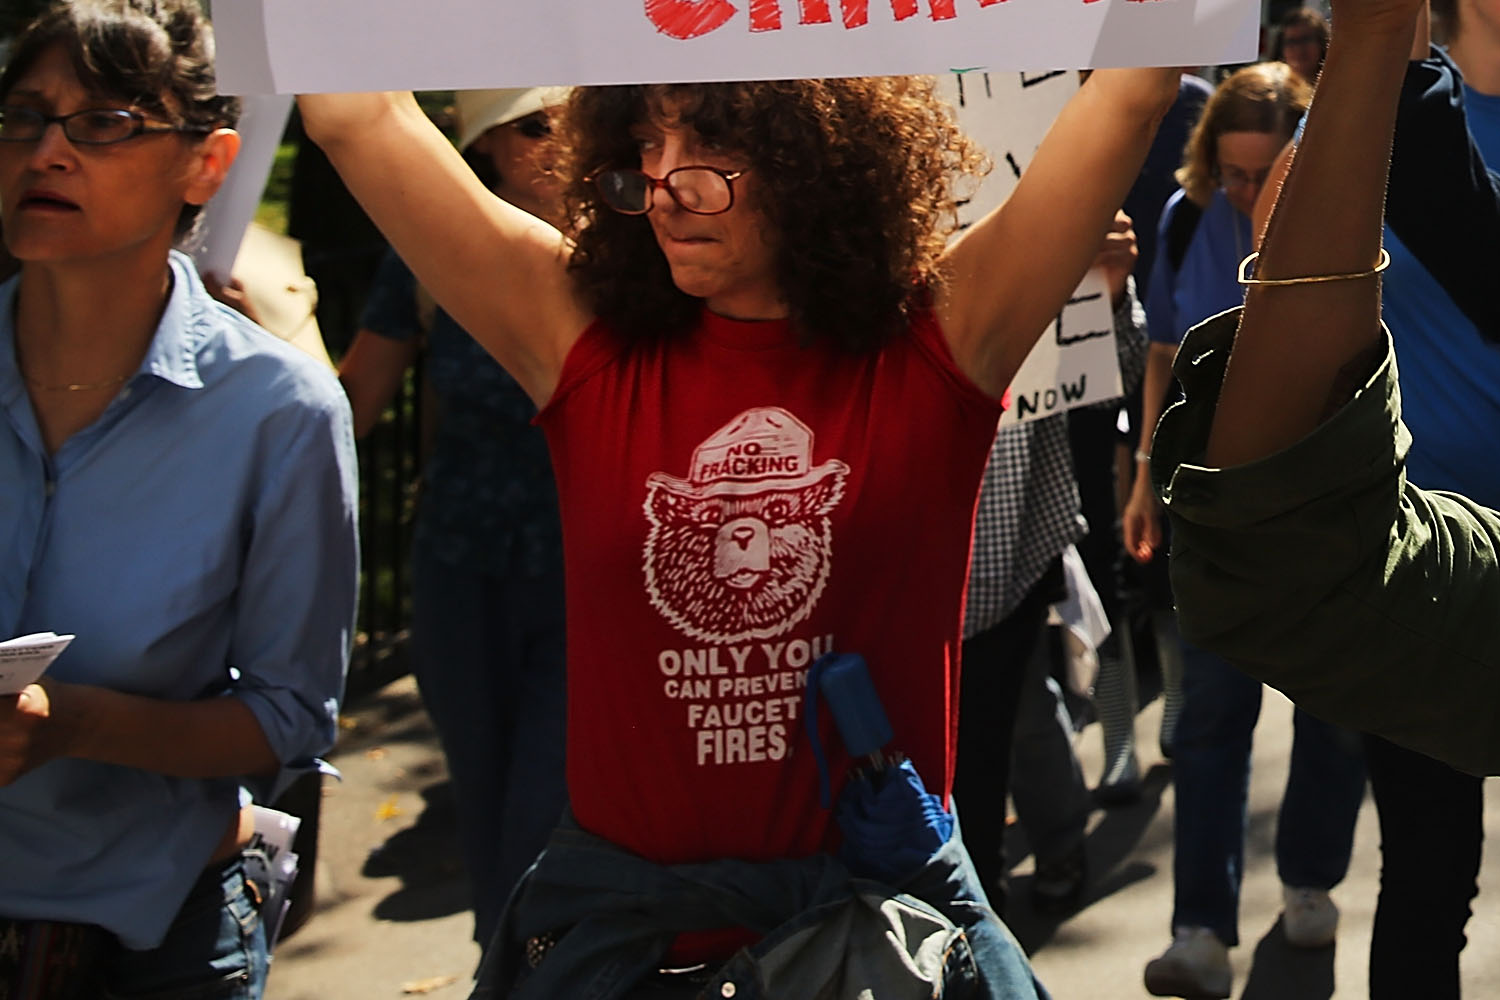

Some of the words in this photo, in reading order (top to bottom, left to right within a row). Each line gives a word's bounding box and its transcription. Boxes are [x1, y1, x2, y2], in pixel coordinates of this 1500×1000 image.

[1017, 374, 1088, 420] NOW
[727, 442, 762, 457] NO
[700, 455, 799, 480] FRACKING
[658, 645, 753, 677] ONLY
[664, 679, 712, 699] CAN
[718, 670, 809, 698] PREVEN
[687, 696, 801, 728] FAUCET
